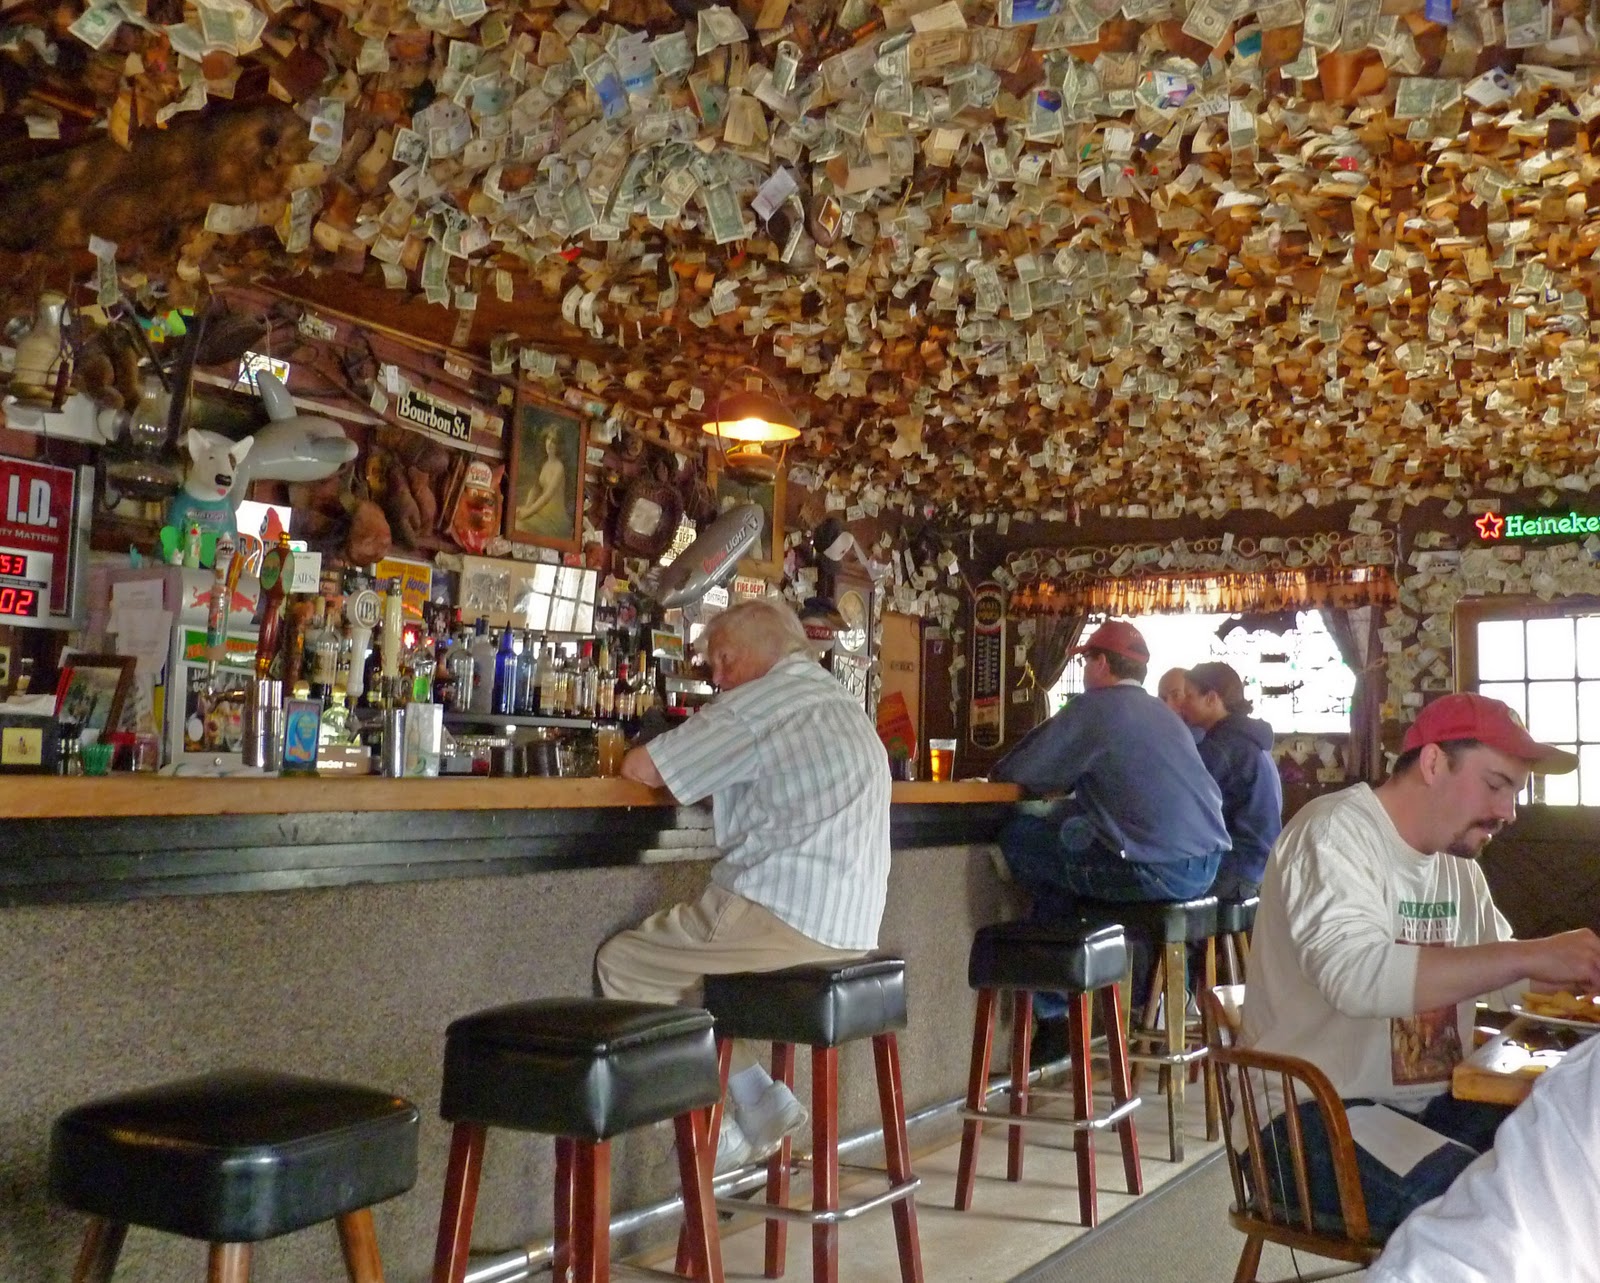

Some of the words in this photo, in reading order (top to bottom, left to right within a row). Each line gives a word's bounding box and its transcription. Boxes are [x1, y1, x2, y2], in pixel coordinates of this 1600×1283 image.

[400, 396, 452, 434] Bourbon
[452, 415, 468, 440] St.
[7, 475, 58, 528] I.D.
[15, 529, 59, 544] MATTERS
[1505, 511, 1600, 537] Heineke
[703, 549, 727, 575] Coors
[726, 527, 747, 553] LIGHT
[707, 592, 728, 606] DISTRICT
[736, 582, 749, 592] FIRE
[749, 583, 765, 594] DEPT
[0, 588, 34, 615] 02
